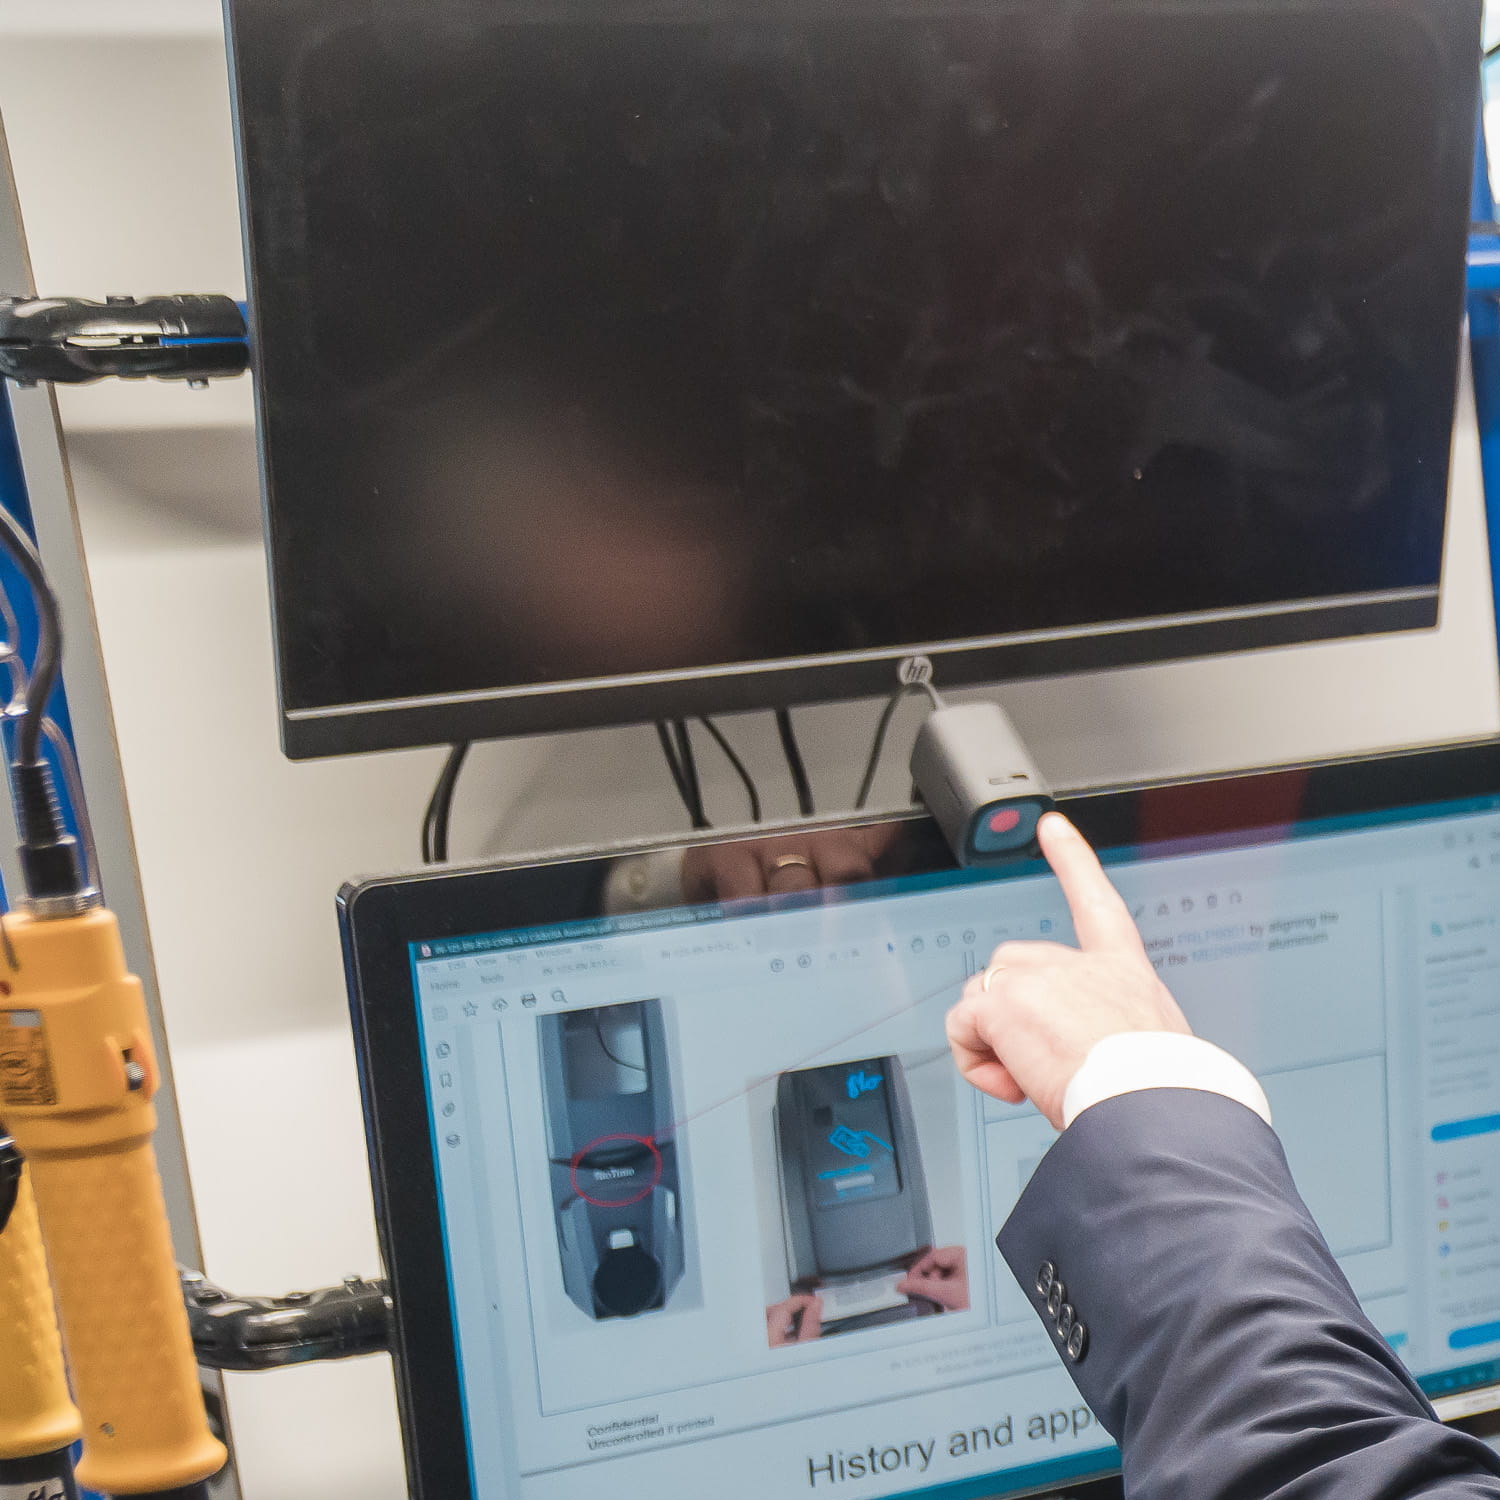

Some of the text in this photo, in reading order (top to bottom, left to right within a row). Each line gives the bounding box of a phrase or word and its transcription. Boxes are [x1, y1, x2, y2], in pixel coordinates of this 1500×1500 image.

[587, 1414, 660, 1437] Confidential
[588, 1426, 665, 1450] Uncontrolled
[676, 1415, 716, 1434] printed
[806, 1405, 1099, 1488] History and app
